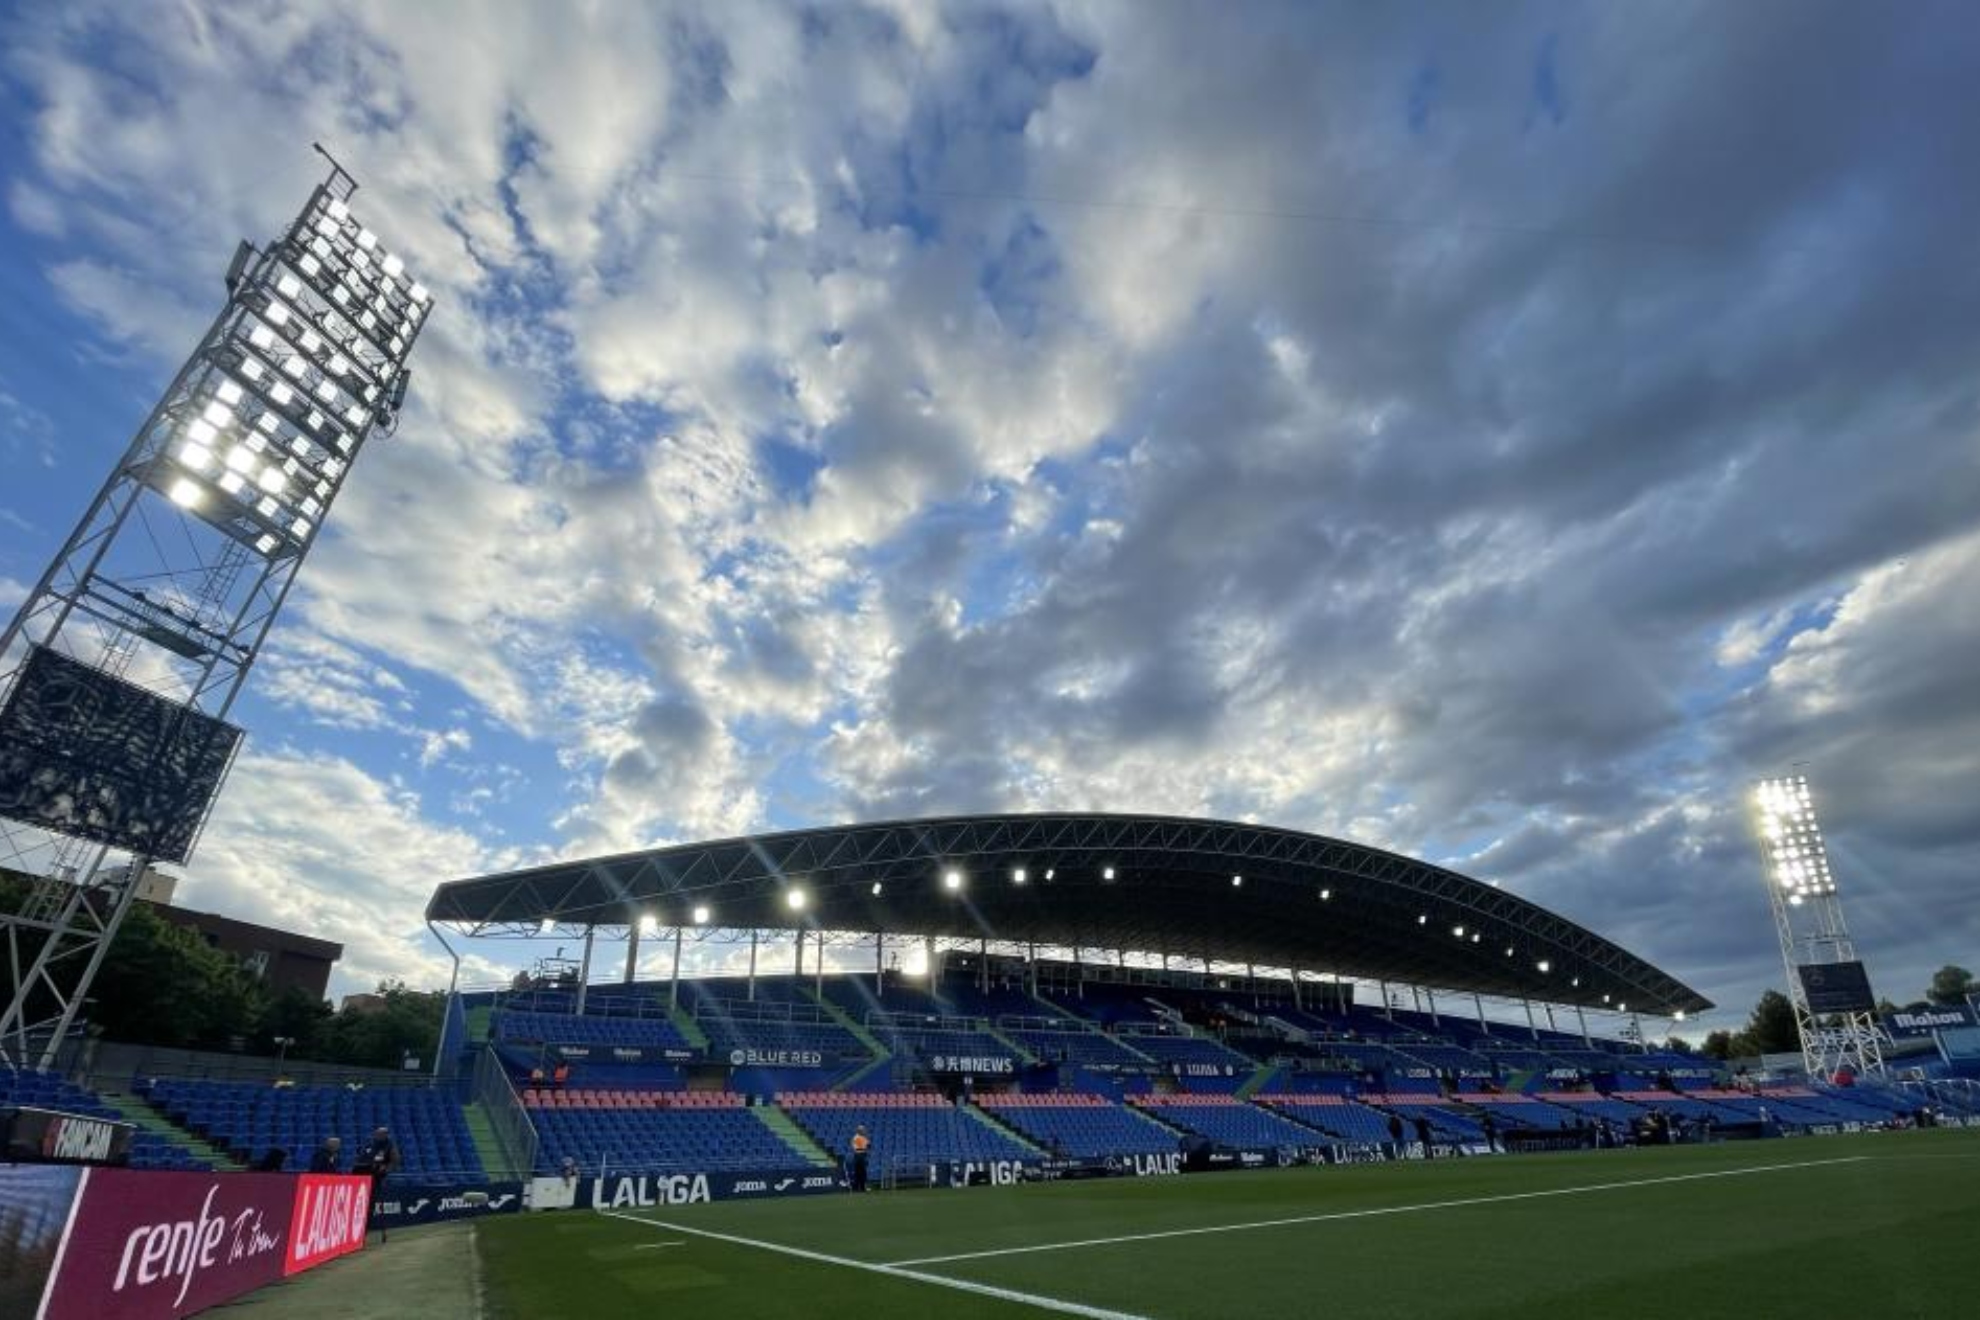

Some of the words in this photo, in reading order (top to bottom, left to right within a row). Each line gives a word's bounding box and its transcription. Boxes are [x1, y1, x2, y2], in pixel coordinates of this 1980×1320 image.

[1893, 1011, 1965, 1029] Mahou
[747, 1050, 788, 1064] BLUE
[791, 1051, 821, 1064] RED
[113, 1183, 225, 1308] renfe
[294, 1184, 353, 1260] LALIGA
